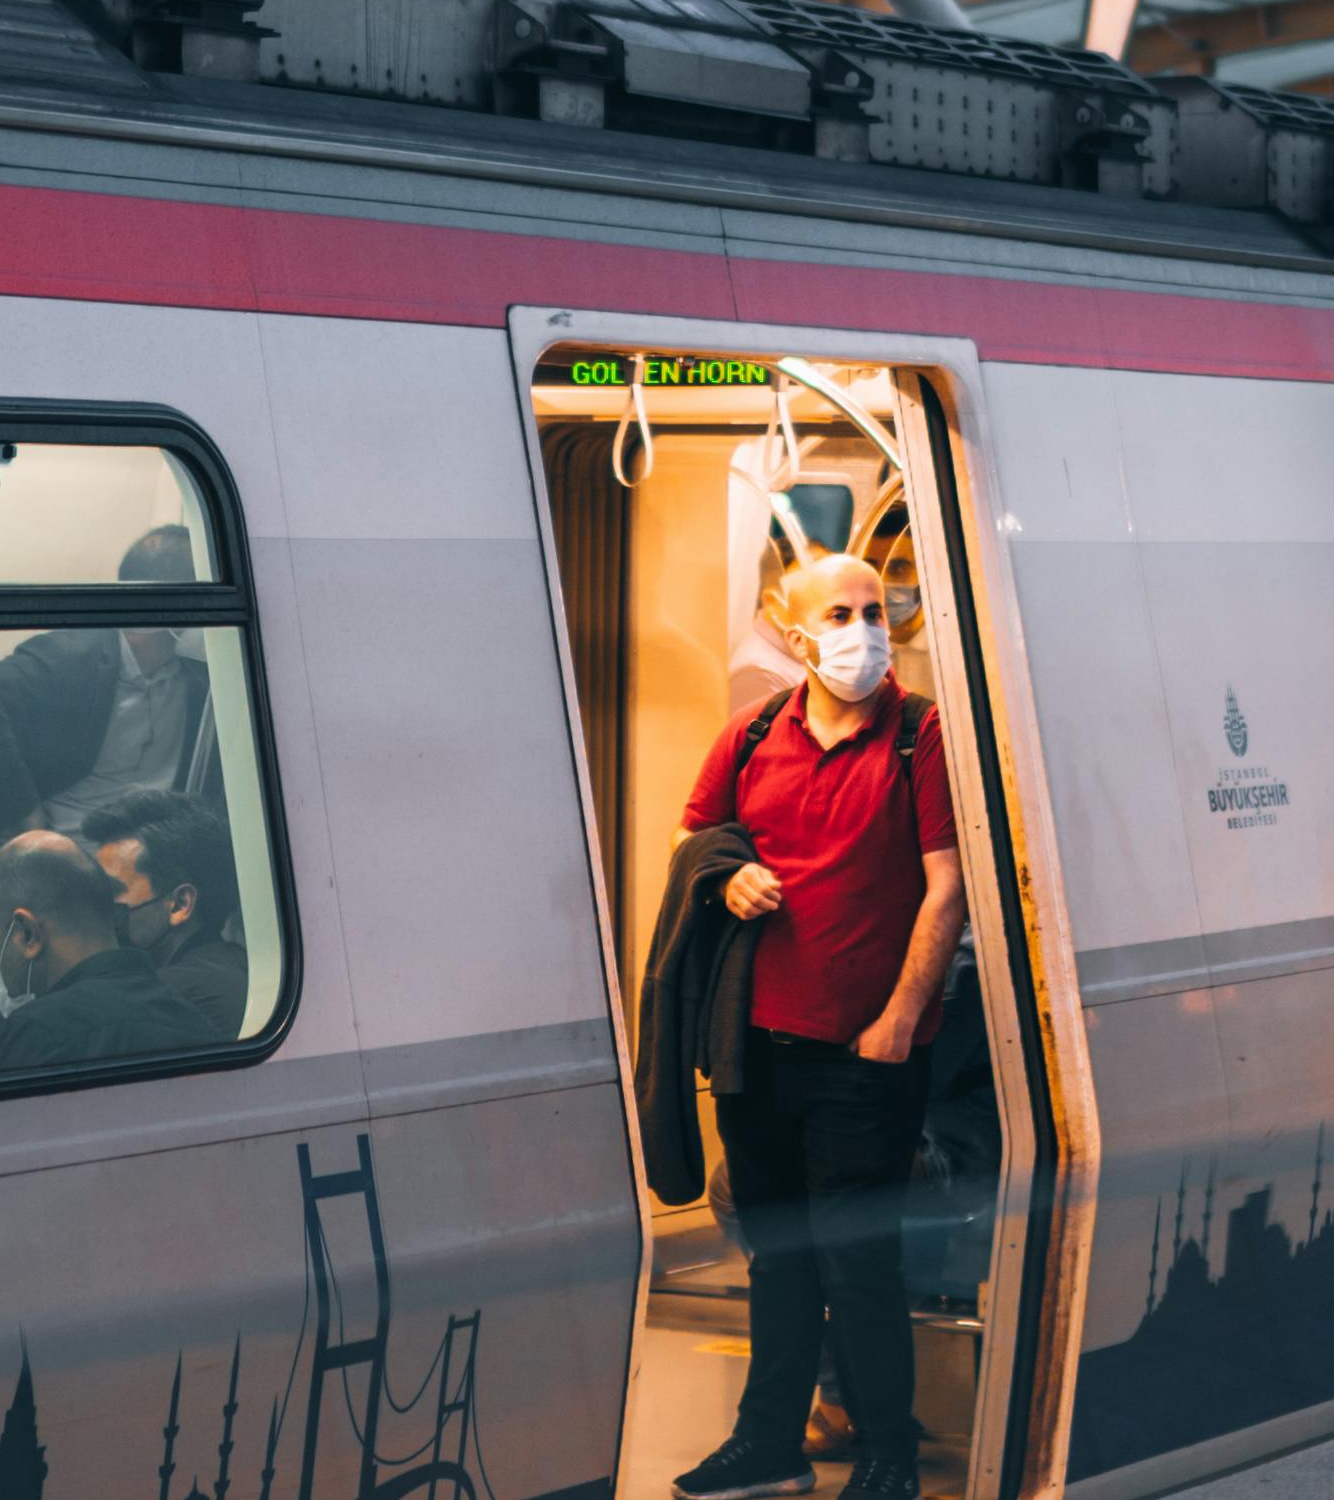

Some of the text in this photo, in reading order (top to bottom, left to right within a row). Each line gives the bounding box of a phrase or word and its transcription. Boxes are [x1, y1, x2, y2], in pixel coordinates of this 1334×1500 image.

[572, 361, 765, 384] GOLEN HORN
[1208, 778, 1290, 815] BÜYÜKŞEHİR
